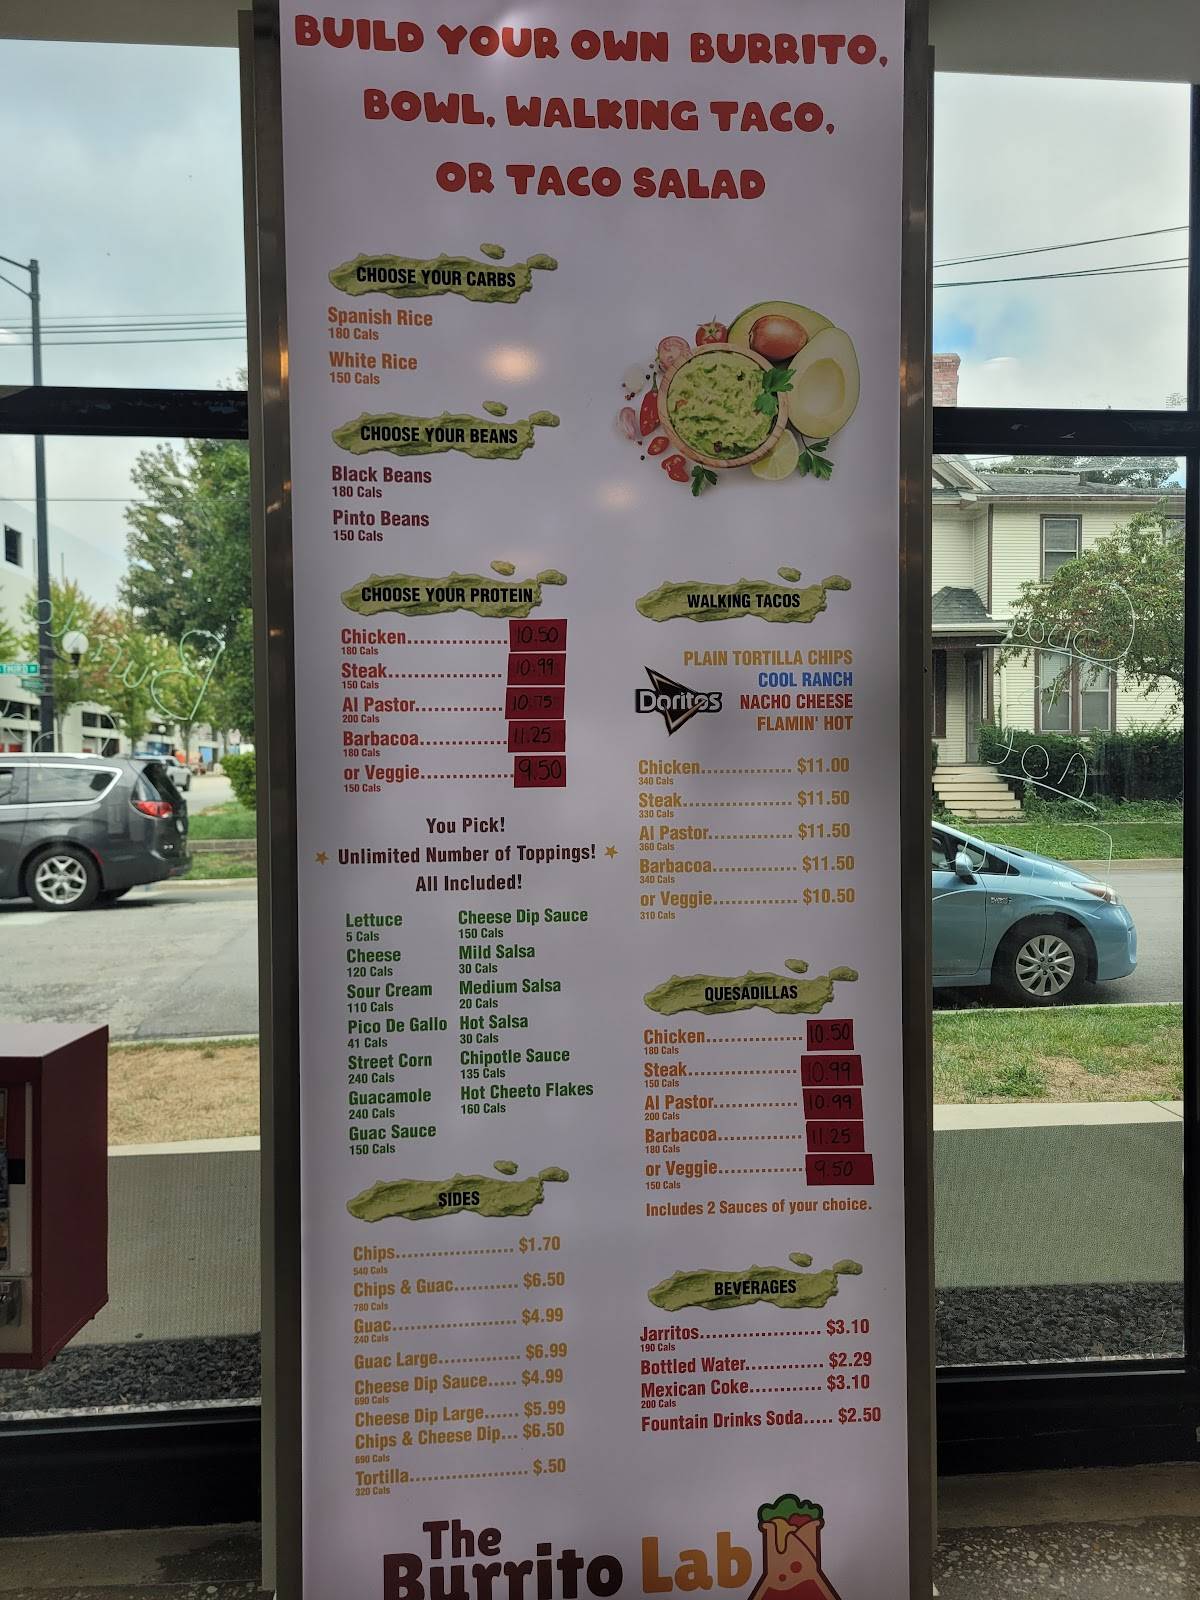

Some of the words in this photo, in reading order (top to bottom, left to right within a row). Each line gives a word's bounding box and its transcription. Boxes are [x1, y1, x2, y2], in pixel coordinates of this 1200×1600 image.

[295, 15, 424, 52] BUILD
[437, 24, 559, 59] YOUR
[571, 30, 668, 62] OWN
[691, 33, 887, 67] BURRITO,
[364, 89, 495, 127] BOWL,
[506, 96, 698, 131] WALKING
[710, 102, 834, 134] TACO,
[436, 162, 494, 193] OR
[506, 165, 621, 197] TACO
[634, 167, 765, 199] SALAD
[355, 265, 417, 285] CHOOSE
[420, 267, 462, 288] YOUR
[465, 268, 517, 289] CARBS
[328, 307, 391, 331] Spanish
[398, 310, 432, 326] Rice
[328, 326, 349, 339] 180
[354, 328, 379, 340] Cals
[330, 352, 375, 371] White
[382, 353, 417, 369] Rice
[330, 372, 351, 383] 150
[355, 372, 380, 384] Cals
[360, 425, 421, 443] CHOOSE
[423, 427, 466, 443] YOUR
[470, 428, 517, 445] BEANS
[332, 466, 377, 481] Black
[384, 467, 431, 483] Beans
[332, 486, 353, 497] 180
[358, 486, 382, 497] Cals
[333, 510, 375, 525] Pinto
[381, 511, 429, 526] Beans
[334, 530, 354, 541] 150
[358, 530, 383, 541] Cals
[361, 586, 420, 602] CHOOSE
[425, 587, 465, 603] YOUR
[471, 587, 534, 603] PROTEIN
[686, 593, 751, 609] WALKING
[755, 593, 801, 609] TACOS
[517, 626, 558, 644] 10.50
[684, 651, 727, 665] PLAIN
[733, 651, 803, 665] TORTILLA
[808, 650, 852, 665] CHIPS
[516, 658, 554, 675] 10.99
[759, 672, 797, 687] COOL
[803, 672, 852, 686] RANCH
[343, 697, 358, 712] Al
[514, 695, 552, 710] 10.75
[636, 688, 722, 714] Doritos
[741, 694, 790, 709] NACHO
[797, 694, 853, 708] CHEESE
[758, 716, 818, 731] FLAMIN'
[824, 716, 853, 730] HOT
[514, 727, 551, 744] 11.25
[344, 769, 359, 780] or
[519, 759, 562, 781] 9.50
[798, 758, 849, 775] $11.00
[426, 818, 455, 833] You
[463, 817, 504, 832] Pick!
[339, 848, 419, 864] Unlimited
[427, 847, 488, 862] Number
[496, 846, 510, 861] of
[517, 844, 595, 863] Toppings!
[416, 876, 437, 891] All
[445, 874, 521, 890] Included!
[641, 895, 655, 906] or
[803, 888, 855, 905] $10.50
[346, 914, 402, 927] Lettuce
[459, 911, 511, 924] Cheese
[517, 909, 539, 926] Dip
[545, 908, 587, 922] Sauce
[658, 911, 675, 919] Cals
[347, 932, 352, 942] 5
[356, 931, 379, 941] Cals
[347, 949, 400, 963] Cheese
[459, 945, 491, 959] Mild
[496, 944, 535, 958] Salsa
[347, 984, 380, 998] Sour
[386, 983, 432, 997] Cream
[460, 980, 517, 994] Medium
[522, 979, 560, 992] Salsa
[705, 985, 797, 1003] QUESADILLAS
[349, 1020, 380, 1034] Pico
[387, 1019, 404, 1032] De
[410, 1017, 447, 1031] Gallo
[460, 1016, 484, 1029] Hot
[489, 1015, 528, 1028] Salsa
[809, 1024, 849, 1043] 10.50
[348, 1039, 359, 1048] 41
[365, 1037, 387, 1047] Cals
[348, 1055, 393, 1071] Street
[399, 1054, 432, 1067] Corn
[461, 1050, 521, 1068] Chipotle
[526, 1049, 569, 1062] Sauce
[461, 1069, 479, 1079] 135
[483, 1067, 505, 1078] Cals
[809, 1062, 851, 1083] 10.99
[349, 1088, 431, 1105] Guacamole
[461, 1086, 485, 1100] Hot
[491, 1084, 540, 1098] Cheeto
[546, 1082, 593, 1096] Flakes
[461, 1104, 479, 1114] 160
[484, 1103, 505, 1113] Cals
[809, 1095, 851, 1109] 10.99
[350, 1127, 386, 1140] Guac
[391, 1125, 436, 1138] Sauce
[813, 1128, 850, 1145] 11.25
[815, 1160, 853, 1177] 9.50
[437, 1190, 481, 1208] SIDES
[647, 1202, 703, 1216] Includes
[708, 1201, 715, 1214] 2
[720, 1201, 767, 1214] Sauces
[772, 1199, 785, 1212] of
[790, 1202, 818, 1214] your
[823, 1198, 871, 1210] choice.
[715, 1279, 797, 1297] BEVERAGES
[827, 1319, 869, 1336] $3.10
[355, 1355, 391, 1369] Guac
[526, 1343, 567, 1360] $6.99
[641, 1344, 655, 1352] 190
[658, 1343, 675, 1351] Cals
[641, 1358, 695, 1375] Bottled
[829, 1352, 871, 1369] $2.29
[642, 1382, 705, 1399] Mexican
[827, 1375, 869, 1392] $3.10
[642, 1414, 708, 1431] Fountain
[714, 1412, 761, 1427] Drinks
[839, 1407, 881, 1424] $2.50
[356, 1434, 396, 1450] Chips
[402, 1431, 412, 1446] &
[418, 1430, 471, 1444] Cheese
[523, 1422, 564, 1440] $6.50
[422, 1519, 501, 1561] The
[384, 1542, 623, 1600] Burrito
[642, 1532, 753, 1594] Lab
